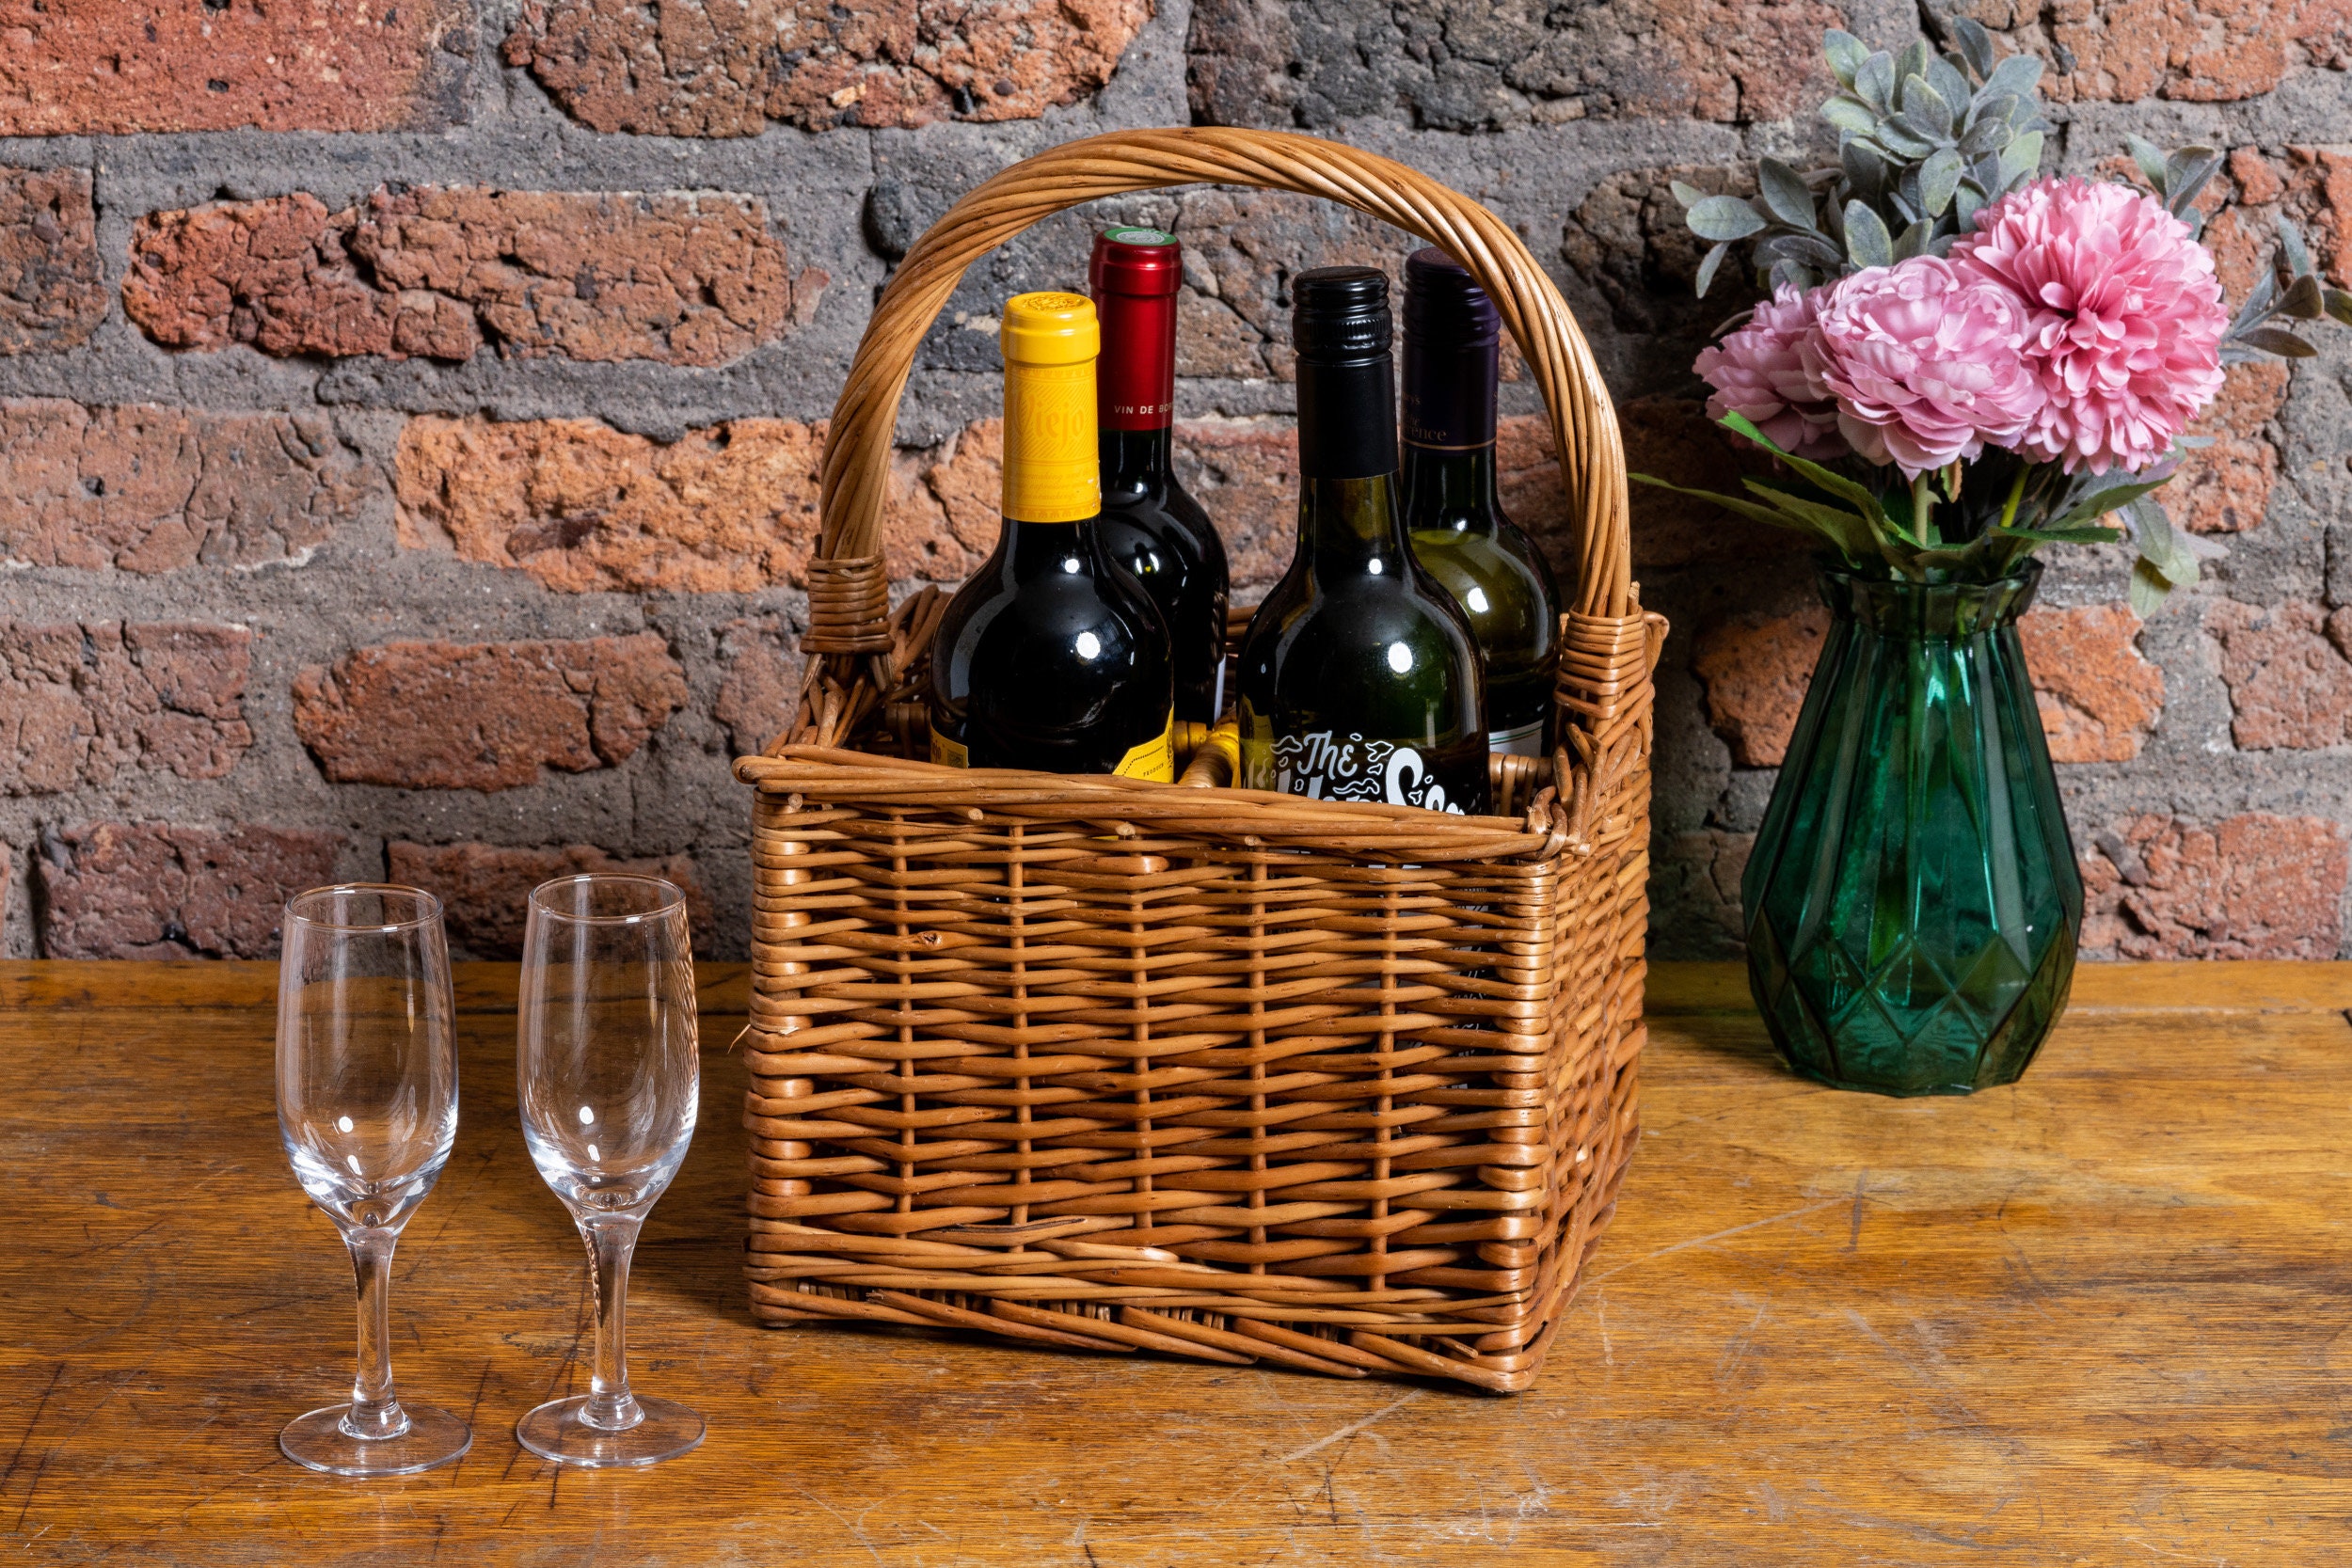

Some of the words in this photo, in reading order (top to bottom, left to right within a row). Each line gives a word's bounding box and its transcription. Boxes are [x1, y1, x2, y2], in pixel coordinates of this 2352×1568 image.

[1011, 390, 1086, 450] Viejo
[1113, 404, 1134, 415] VIN
[1139, 404, 1153, 415] DE
[1297, 730, 1358, 780] The
